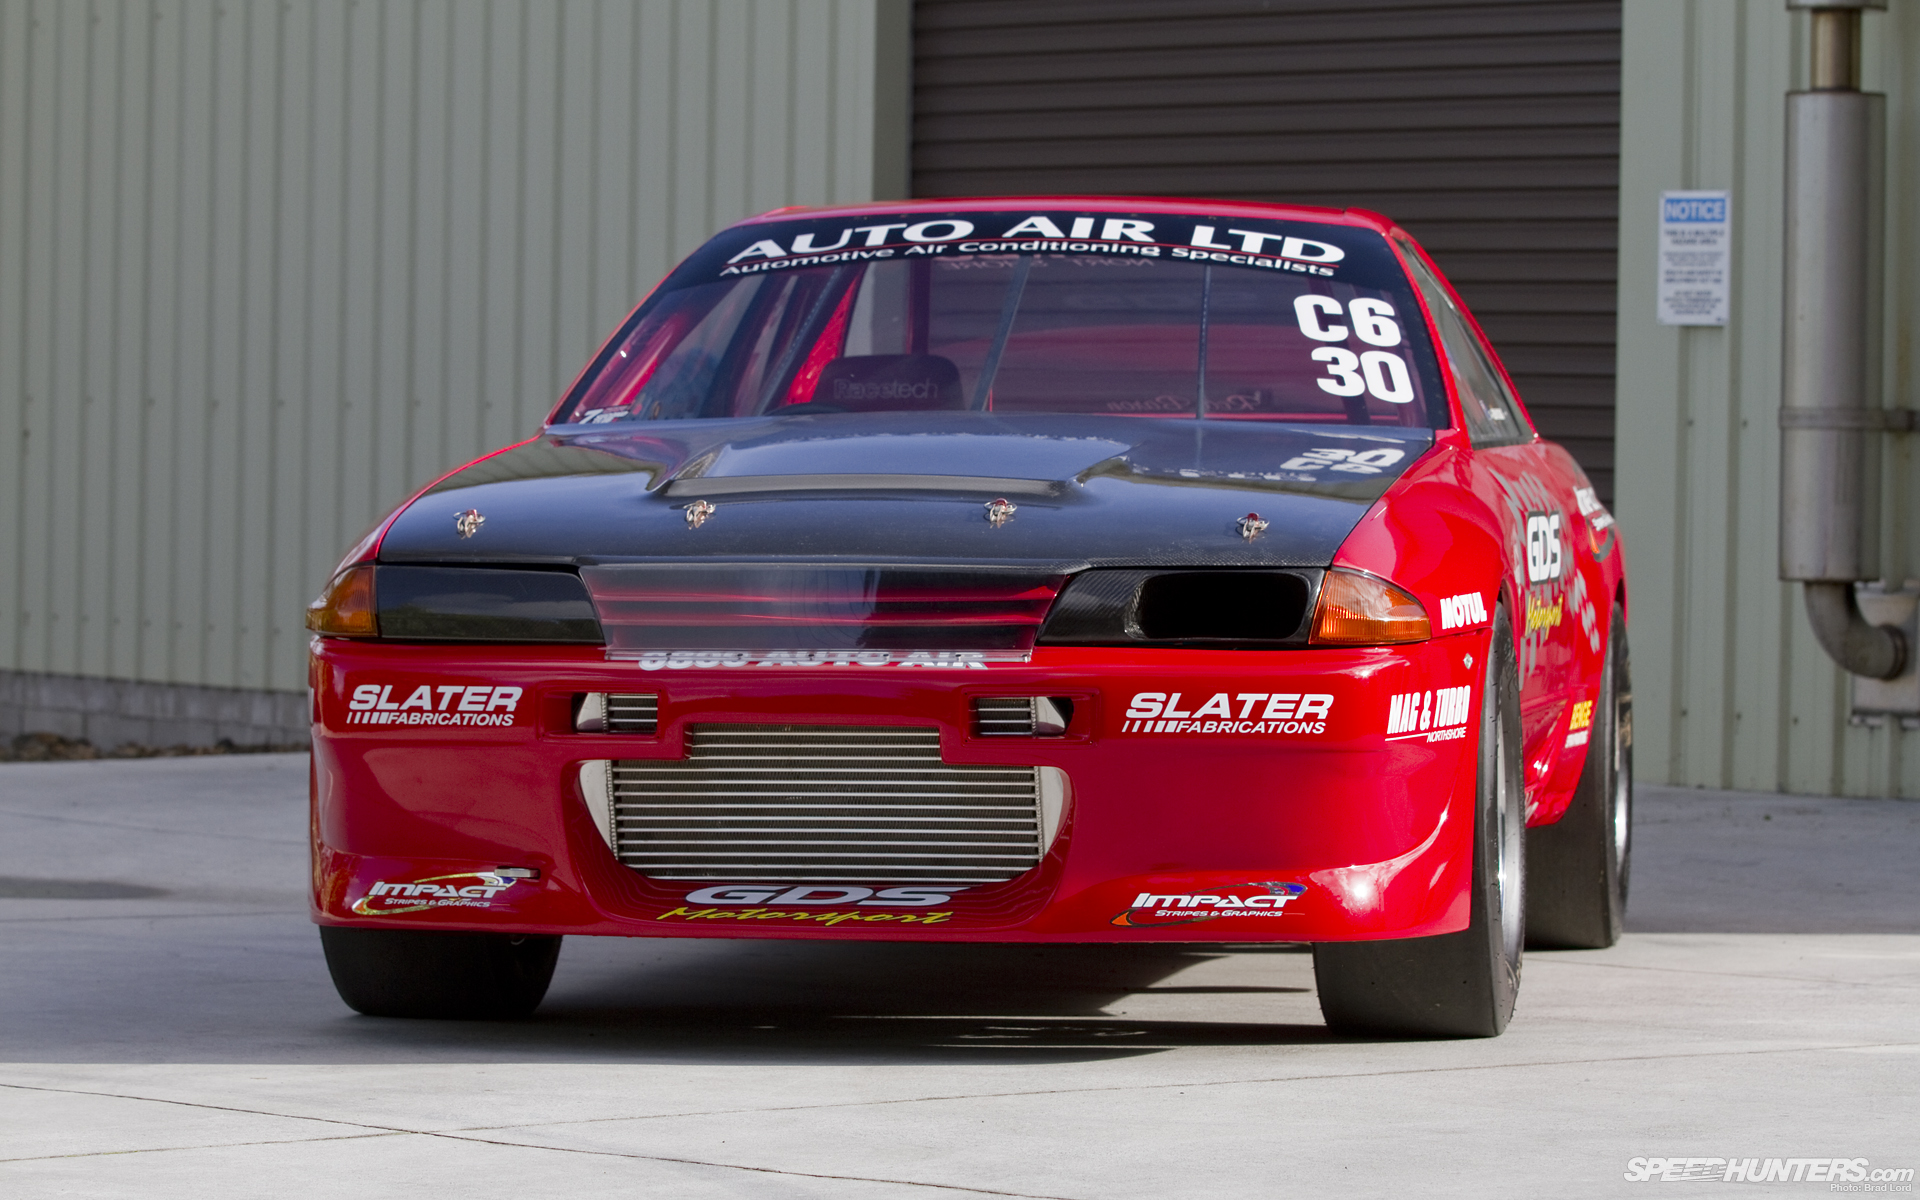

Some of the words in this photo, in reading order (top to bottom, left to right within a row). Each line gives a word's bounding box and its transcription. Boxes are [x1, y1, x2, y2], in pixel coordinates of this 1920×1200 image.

[1665, 201, 1723, 220] NOTICE
[727, 220, 974, 264] AUTO
[1002, 216, 1155, 243] AIR
[1190, 225, 1345, 263] LTD
[719, 248, 895, 277] Automotive
[904, 244, 948, 255] Air
[958, 240, 1160, 257] Conditioning
[1293, 294, 1402, 347] C6
[1311, 346, 1415, 404] 30
[1527, 514, 1562, 583] GDS
[1440, 591, 1488, 630] MOTUL
[897, 651, 988, 670] AIR
[349, 684, 523, 711] SLATER
[1125, 692, 1334, 720] SLATER
[1387, 692, 1421, 734] MAG
[1419, 690, 1432, 731] &
[1433, 685, 1471, 728] TURBO
[387, 712, 515, 726] FABRICATIONS
[1175, 720, 1327, 734] FABRICATIONS
[1426, 726, 1467, 743] NORTHSHORE
[384, 897, 428, 905] STRIPES
[437, 898, 491, 908] GRAPHICS
[686, 884, 971, 907] GDS
[656, 907, 954, 927] Motorsport
[1155, 909, 1209, 917] STRIPES
[1221, 909, 1283, 917] GRAPHICS
